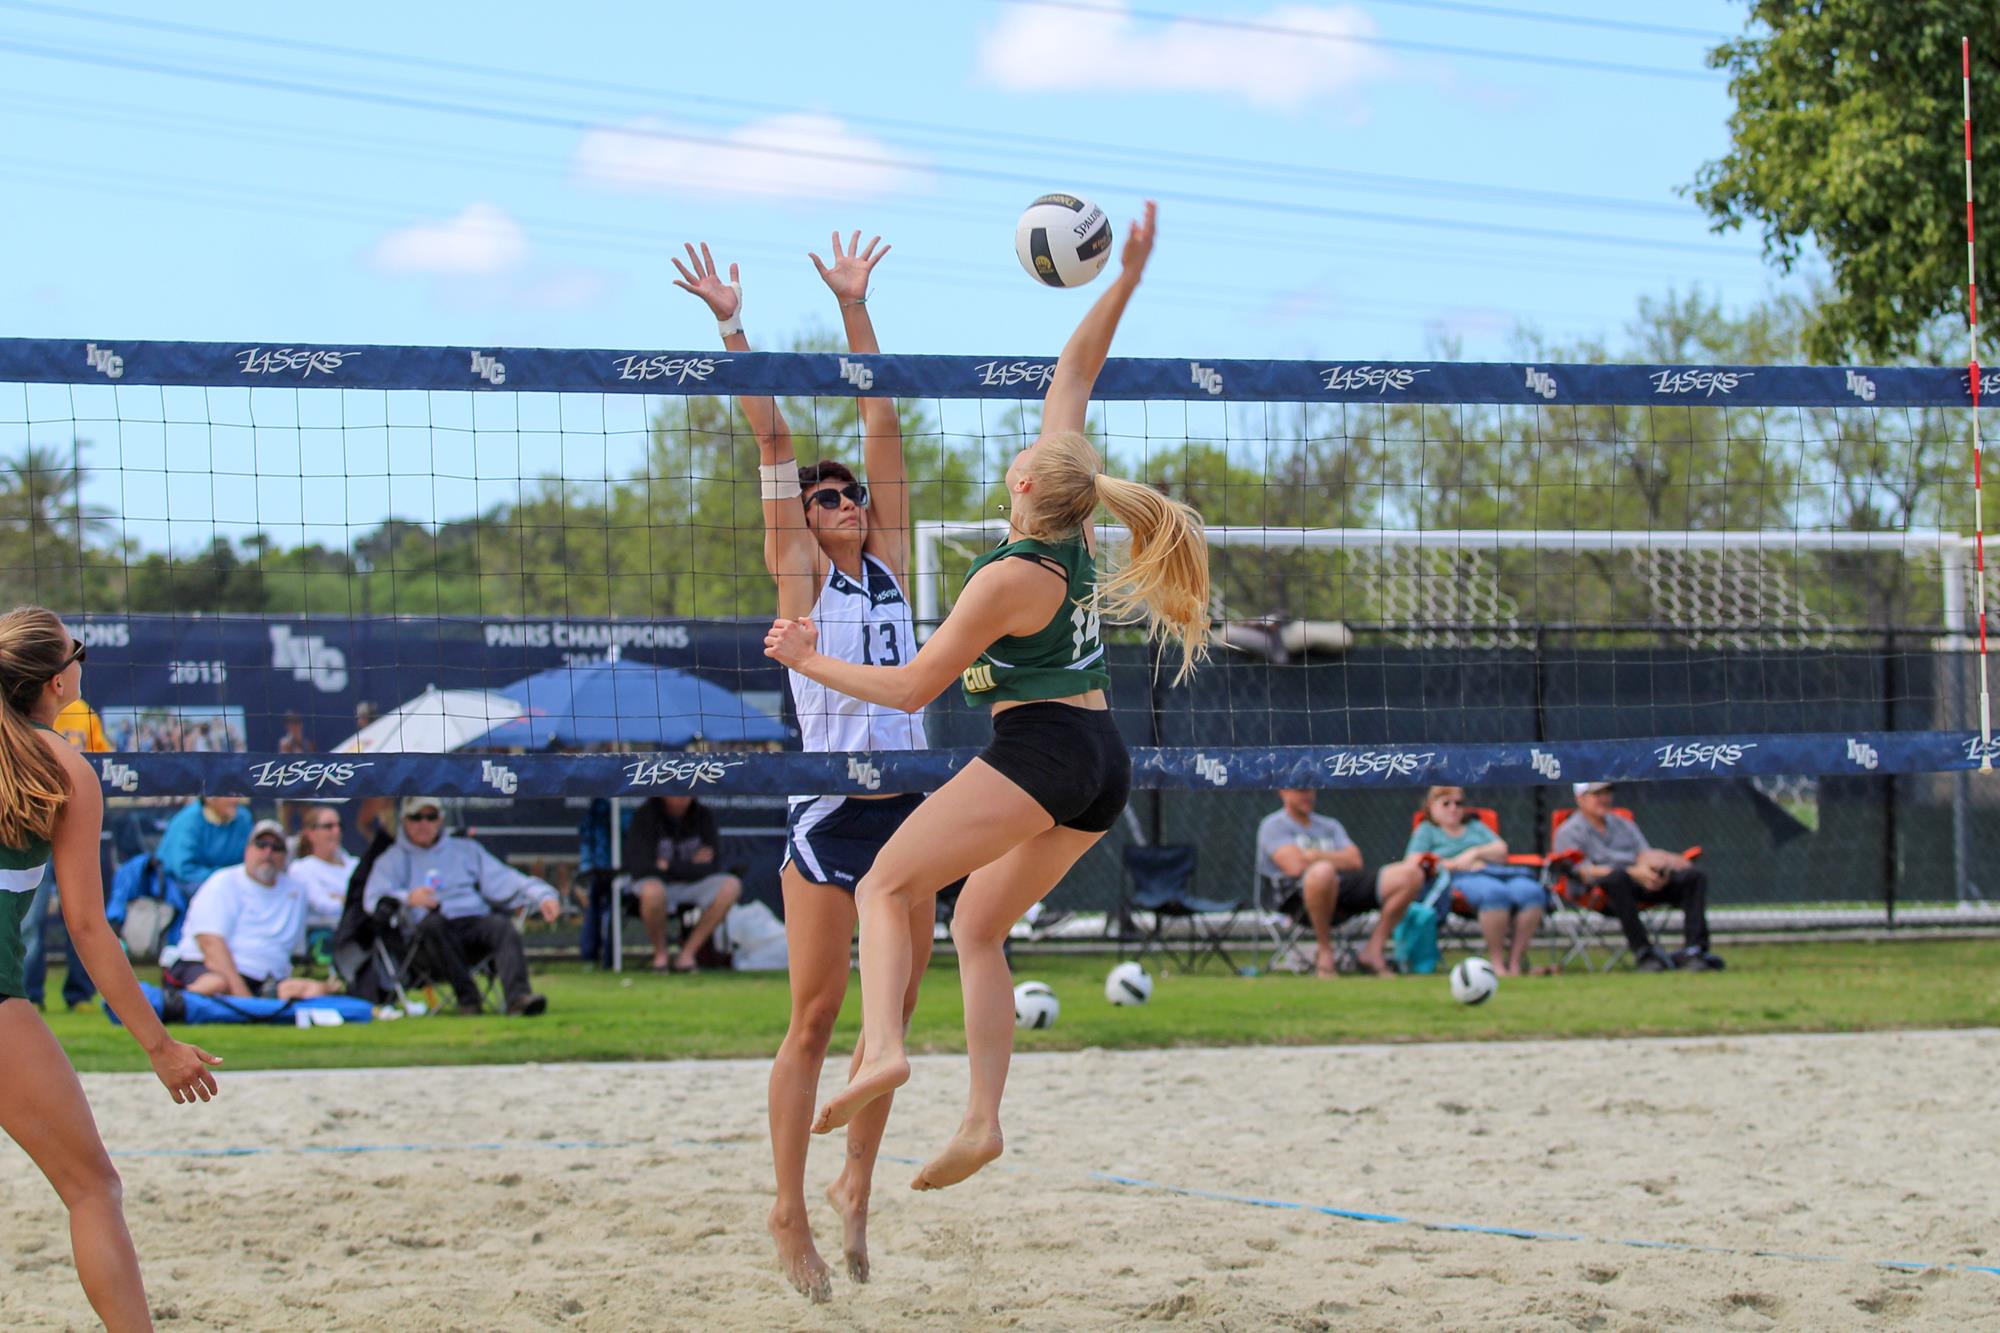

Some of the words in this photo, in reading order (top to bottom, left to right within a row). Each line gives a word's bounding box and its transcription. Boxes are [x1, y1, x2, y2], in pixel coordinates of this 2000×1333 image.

[235, 347, 362, 378] LASERS
[612, 354, 734, 385] LASERS
[974, 360, 1057, 391] LASER
[1319, 365, 1431, 393] LASERS
[1649, 370, 1755, 397] LASERS
[862, 622, 900, 667] 13
[249, 760, 374, 790] LASERS
[622, 760, 744, 788] LASERS
[1324, 752, 1435, 780] LASERS
[1654, 743, 1758, 769] LASERS
